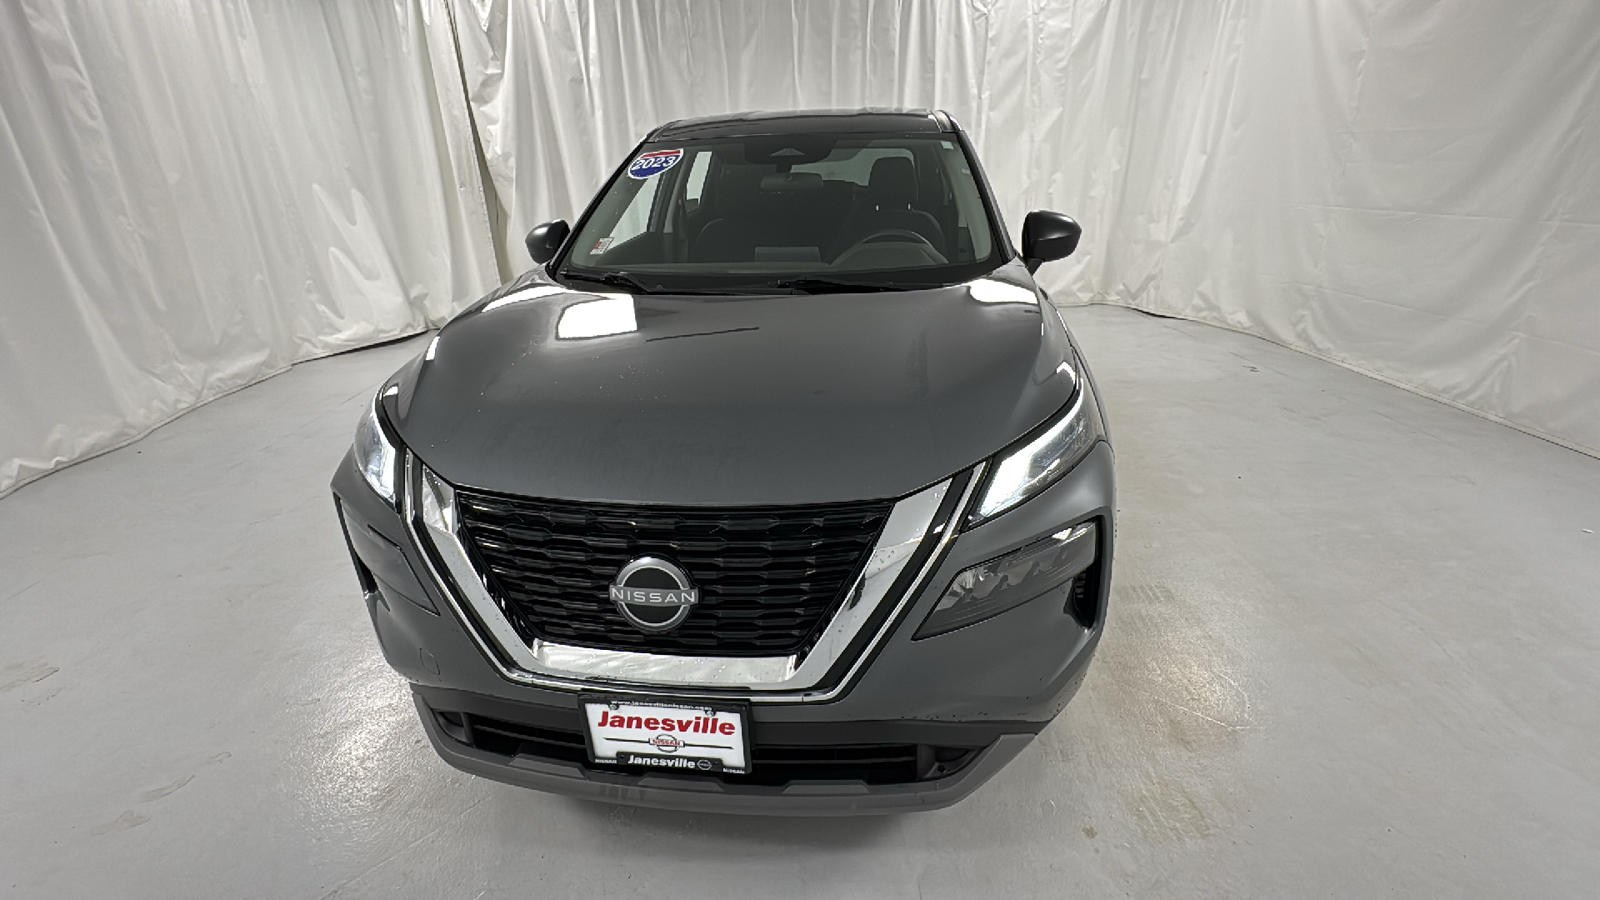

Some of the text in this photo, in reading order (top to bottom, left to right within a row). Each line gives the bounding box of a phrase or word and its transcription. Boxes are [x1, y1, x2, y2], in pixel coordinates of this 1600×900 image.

[630, 156, 676, 170] 2023
[611, 587, 695, 603] NISSAN
[598, 710, 735, 735] Janesville
[652, 738, 680, 746] NISSAN
[628, 754, 695, 769] Janesville
